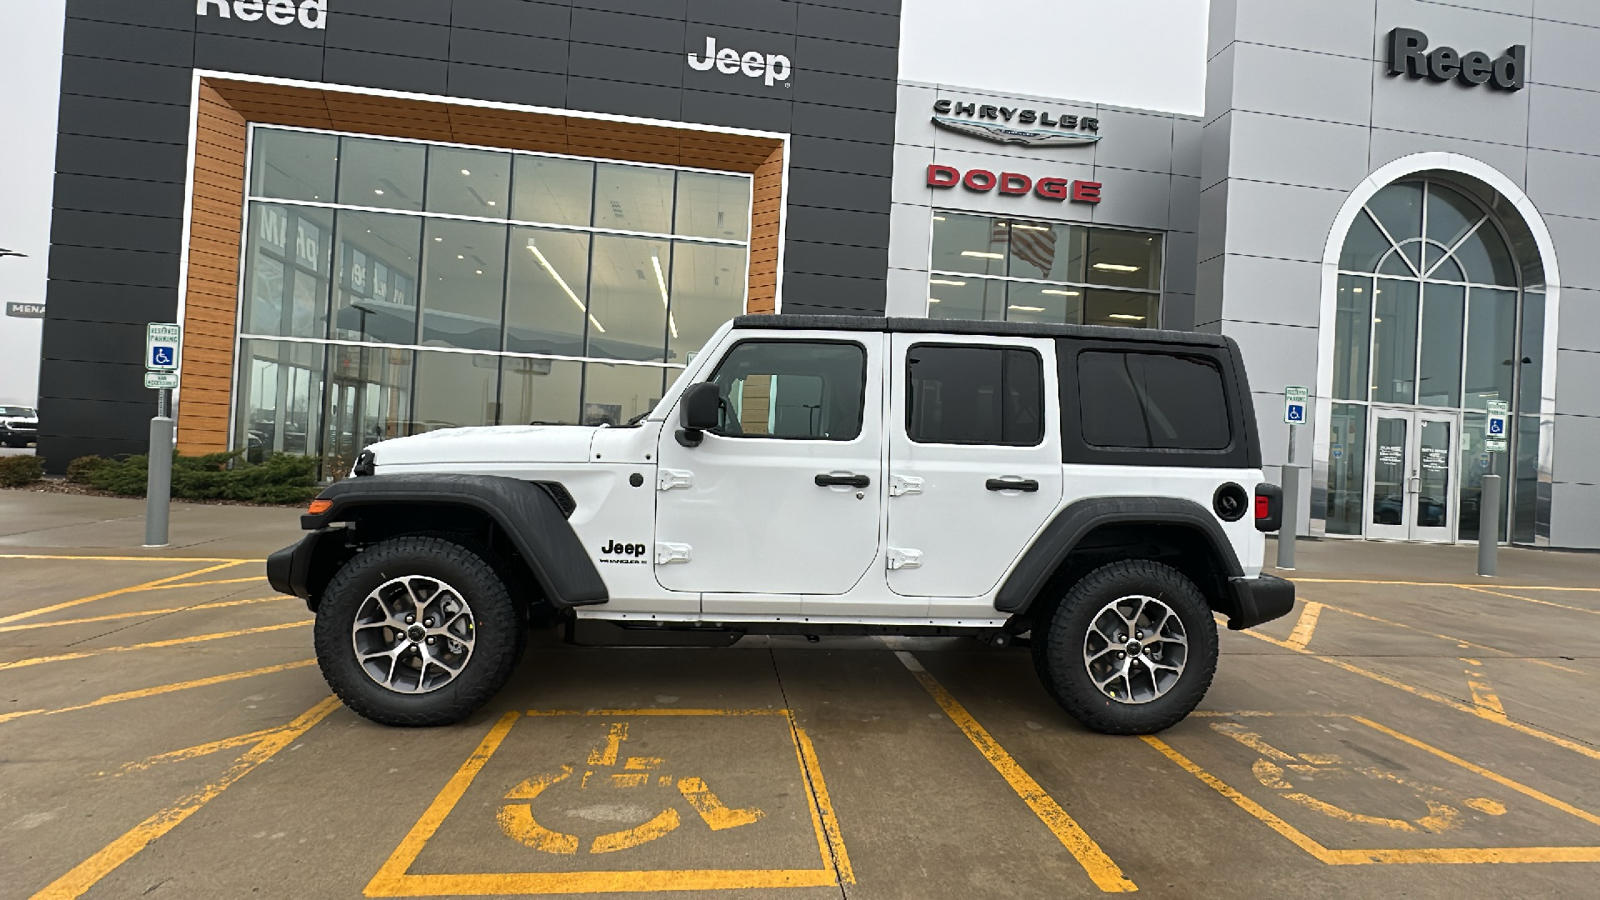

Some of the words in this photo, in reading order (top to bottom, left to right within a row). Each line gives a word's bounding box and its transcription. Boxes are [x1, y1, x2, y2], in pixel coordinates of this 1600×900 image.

[687, 36, 791, 86] Jeep
[1388, 27, 1526, 91] Reed
[933, 99, 1099, 131] CHRYSLER
[927, 164, 1102, 203] DODGE
[602, 540, 645, 557] Jeep
